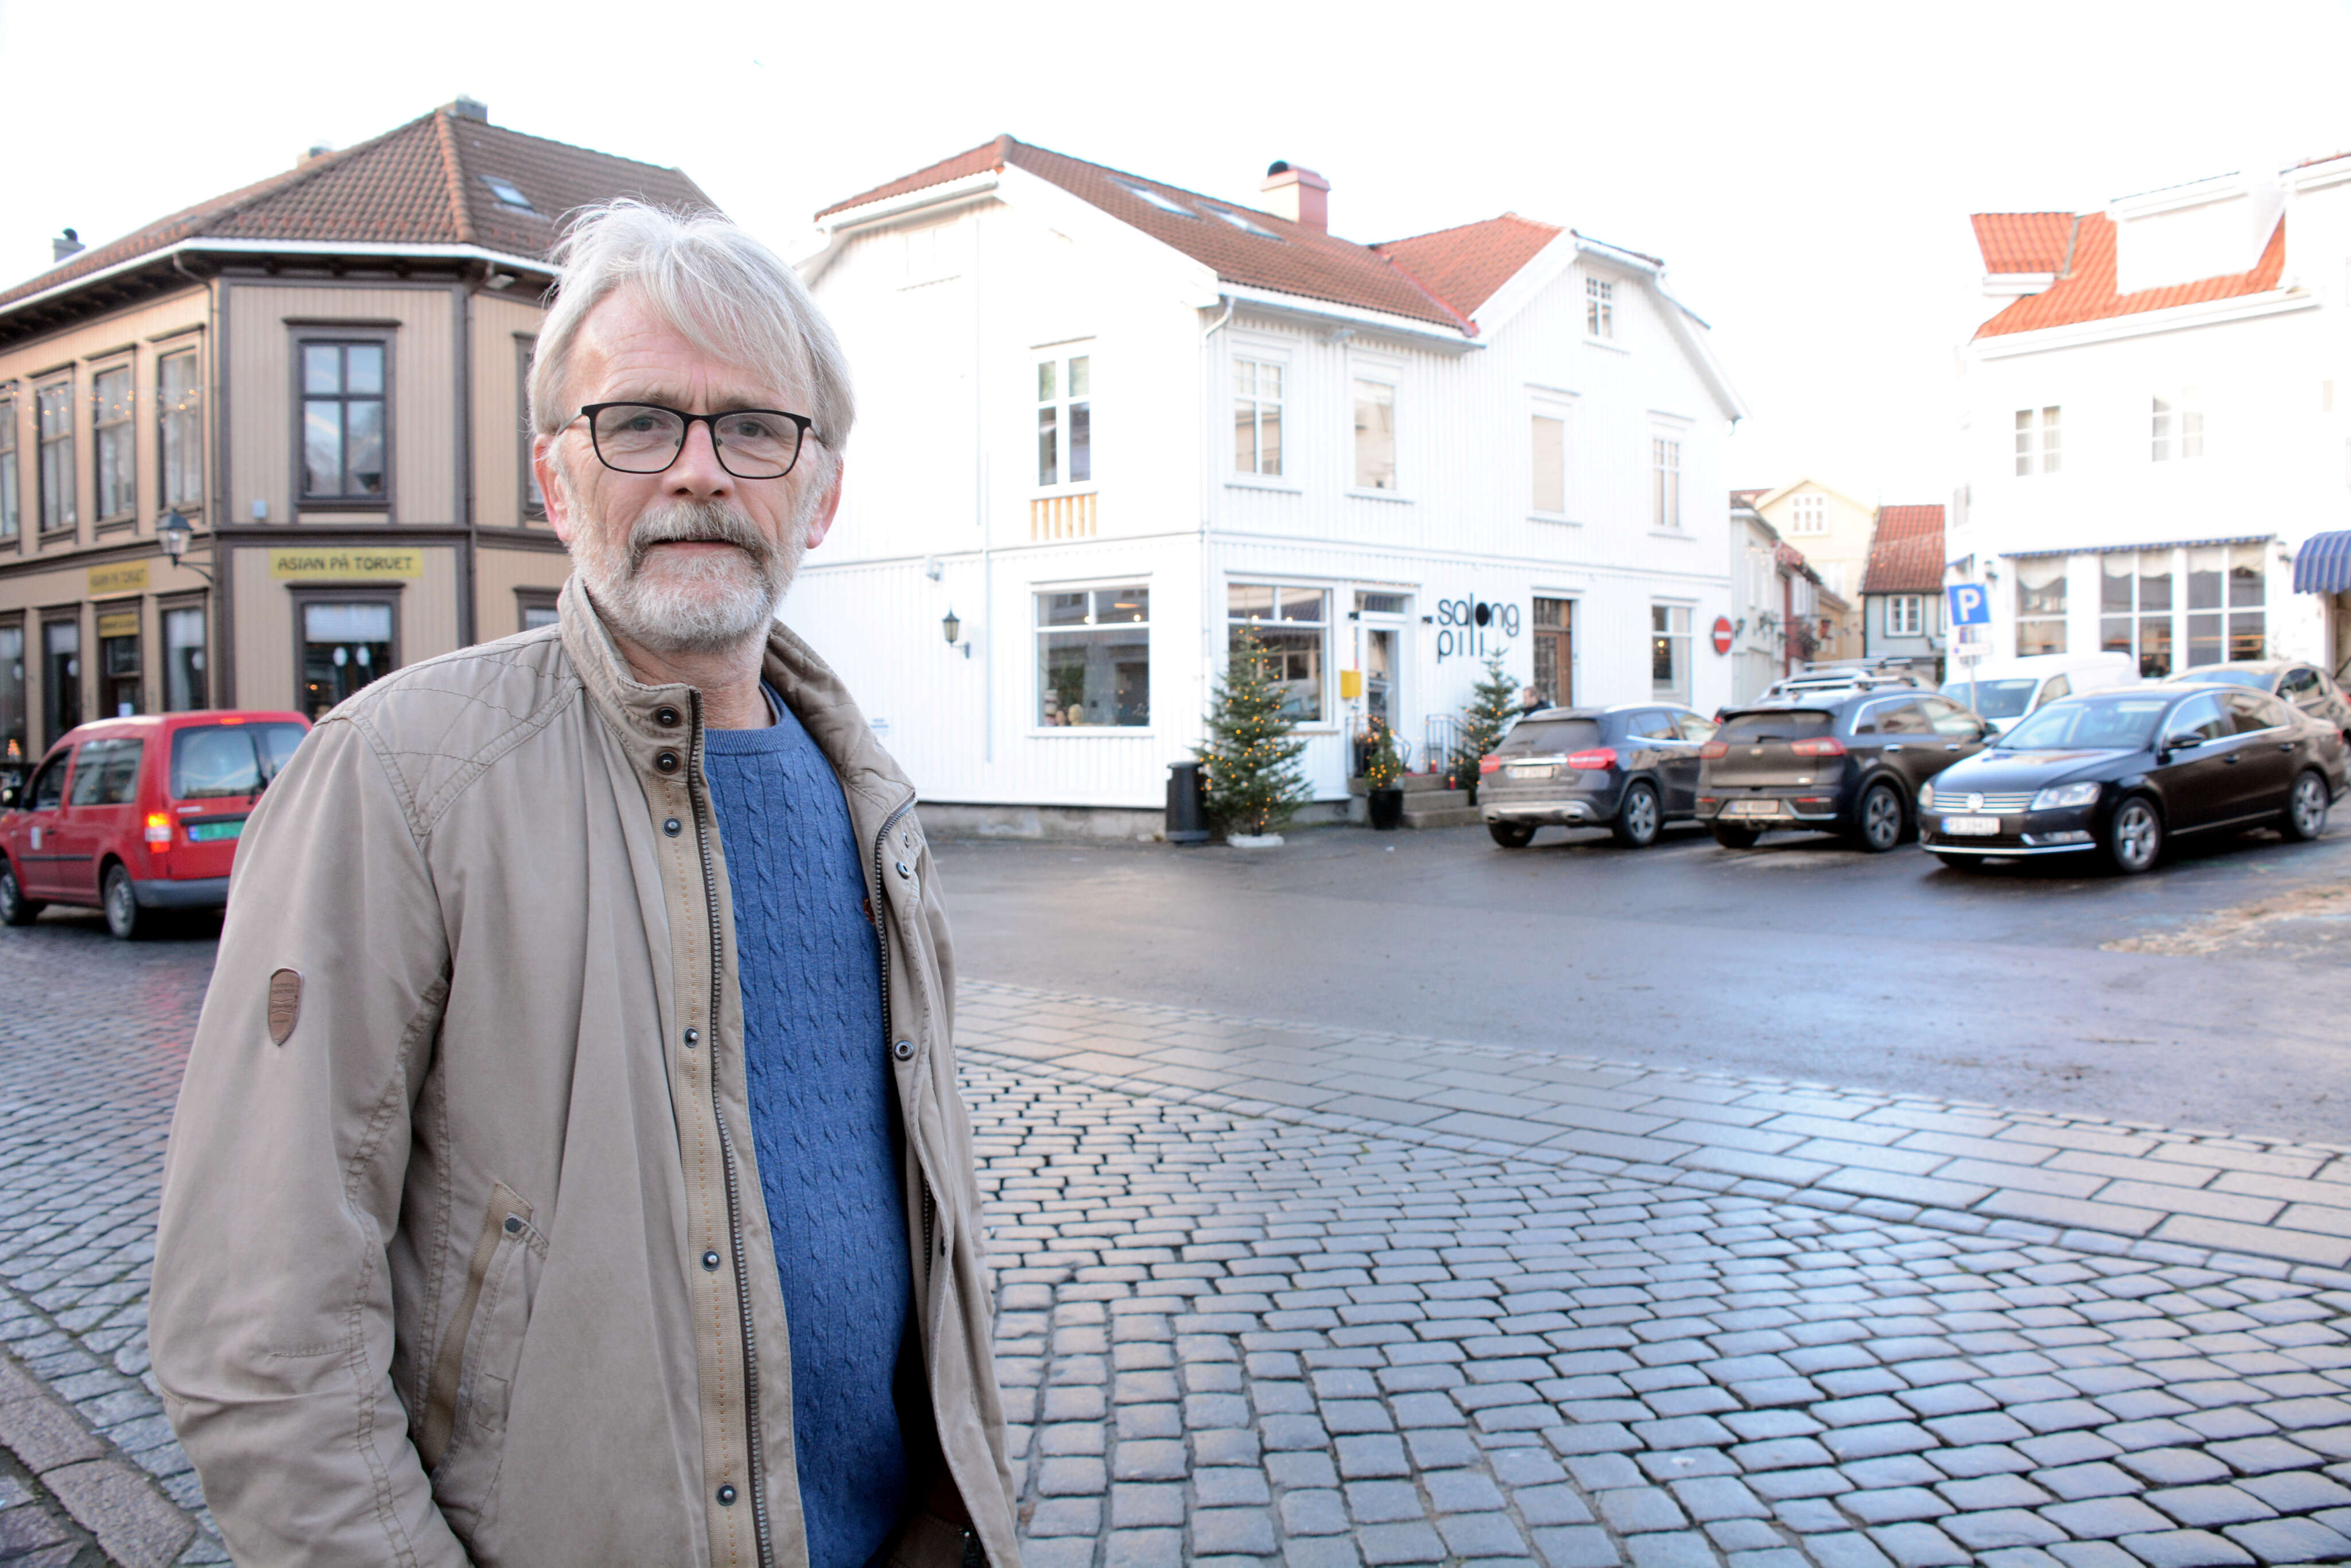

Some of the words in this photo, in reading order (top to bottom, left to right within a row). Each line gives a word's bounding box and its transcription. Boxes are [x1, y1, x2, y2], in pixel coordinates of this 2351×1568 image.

[278, 557, 324, 570] ASIAN
[330, 553, 348, 570] PÅ
[1438, 592, 1519, 637] salong
[1958, 589, 1980, 621] P
[1438, 630, 1484, 664] pili
